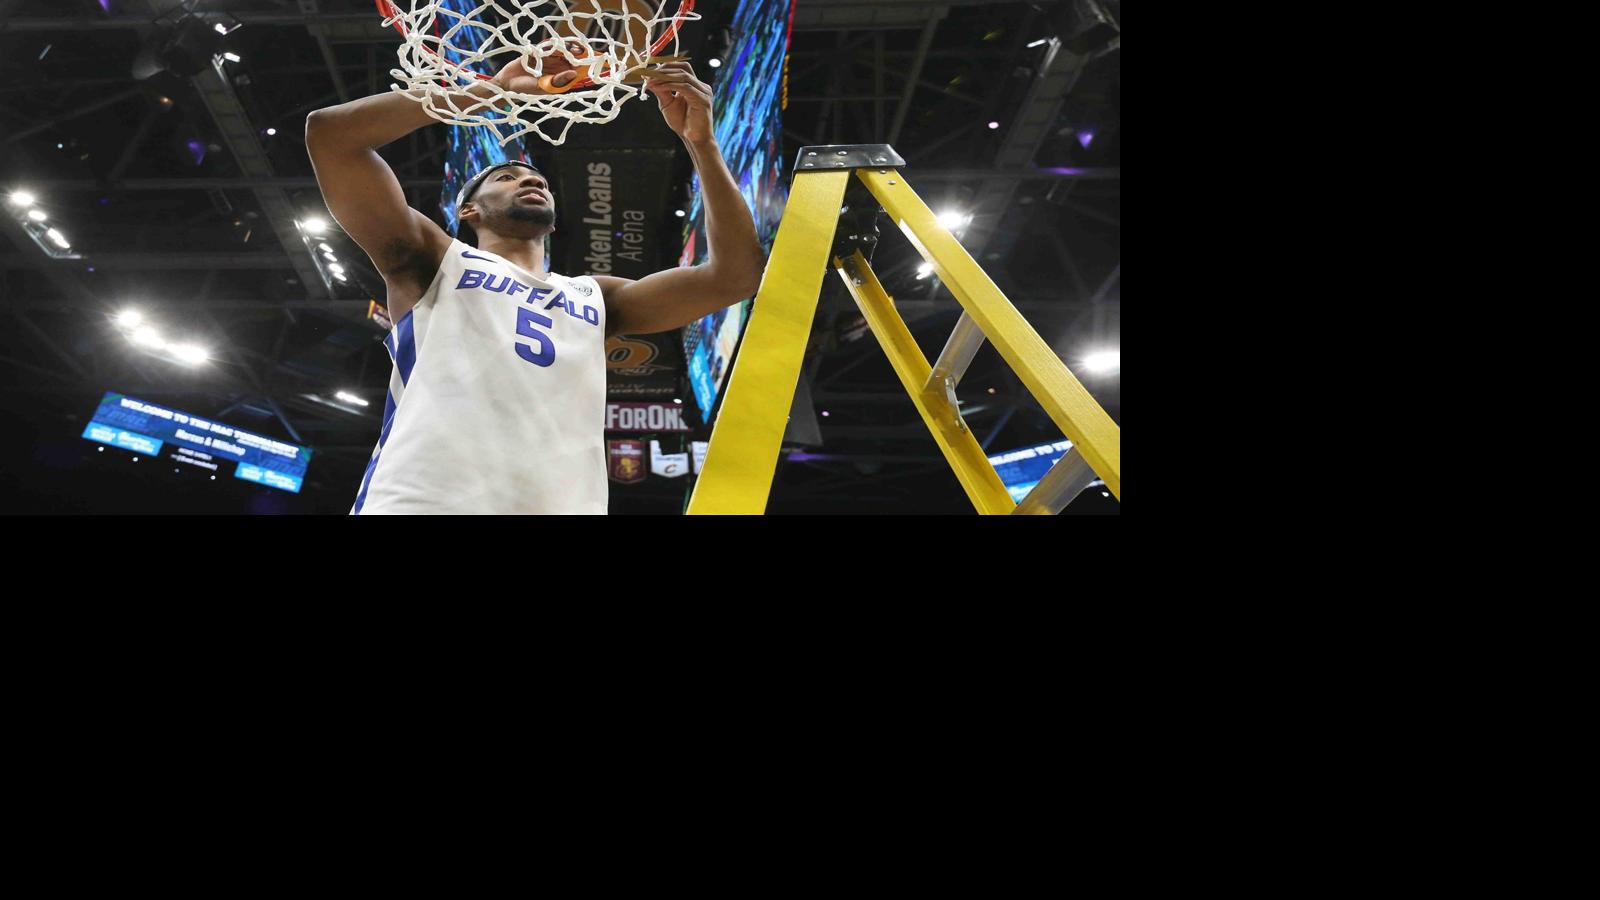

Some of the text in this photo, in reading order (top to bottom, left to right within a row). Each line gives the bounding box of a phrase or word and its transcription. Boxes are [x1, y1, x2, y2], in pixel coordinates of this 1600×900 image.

[583, 162, 612, 277] icken Loans
[616, 210, 645, 262] Arena
[456, 268, 599, 326] BUFFALO
[514, 306, 556, 368] 5
[121, 398, 174, 420] WELCOME
[173, 413, 190, 424] TO
[189, 417, 211, 430] THE
[210, 423, 234, 437] MAC
[233, 430, 300, 455] TOURNAMENT
[988, 448, 1037, 466] ELCOME
[1034, 444, 1054, 456] TO
